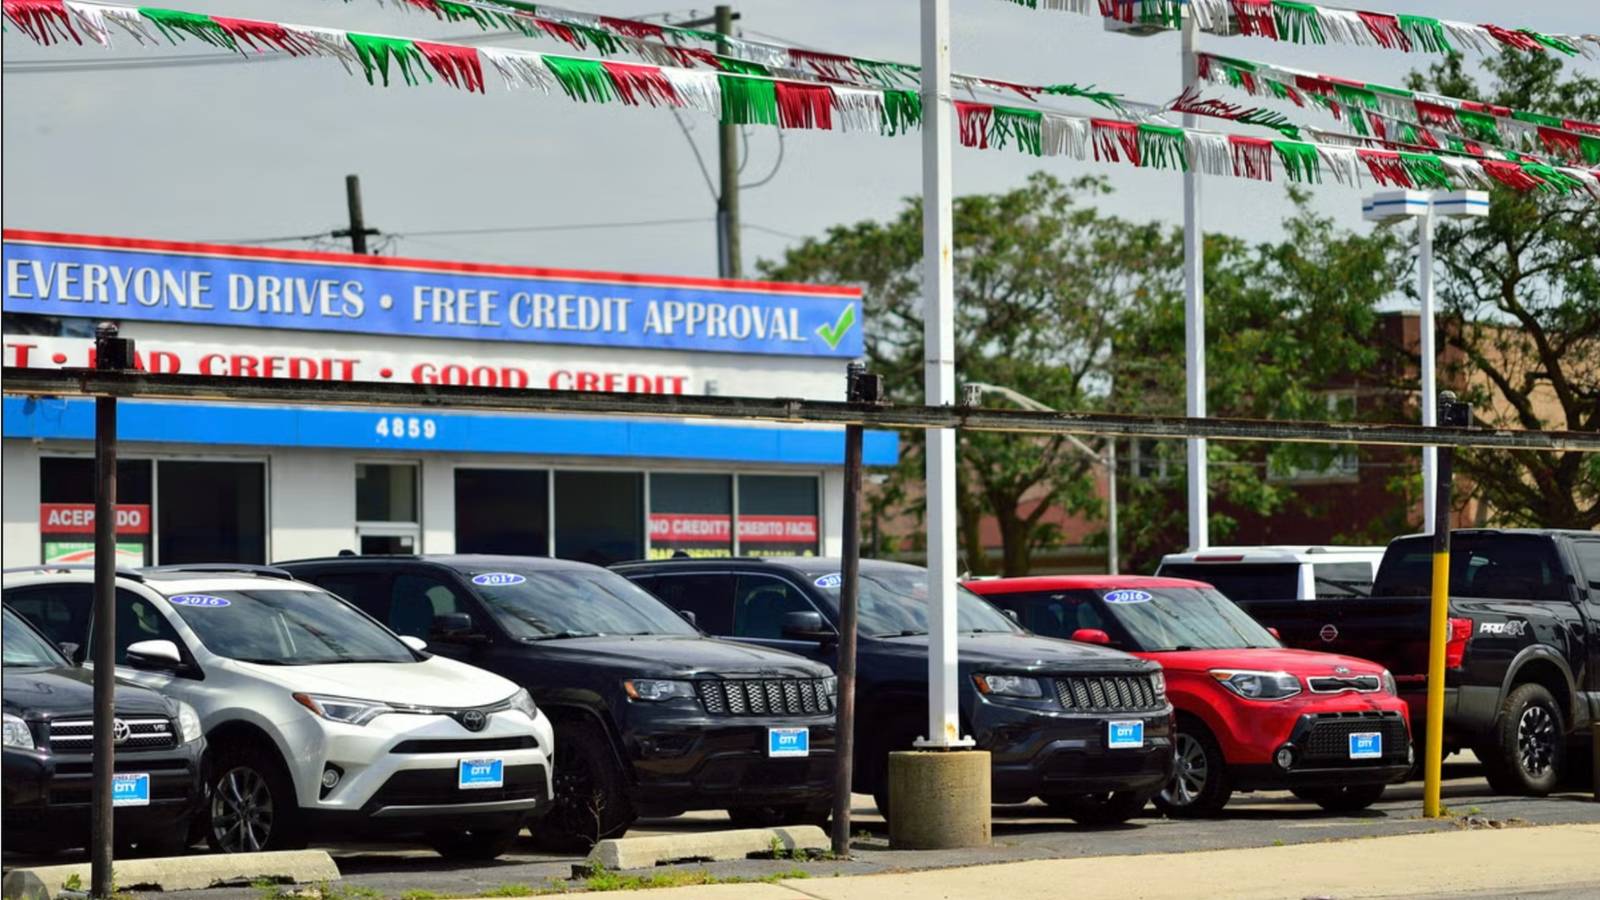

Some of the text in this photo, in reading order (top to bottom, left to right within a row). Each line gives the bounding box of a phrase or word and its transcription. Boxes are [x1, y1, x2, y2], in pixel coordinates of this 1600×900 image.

[7, 258, 807, 342] EVERYONE DRIVES FREE CREDIT APPROVAL
[411, 363, 529, 389] GOOD
[376, 416, 436, 439] 4859
[484, 574, 515, 585] 2017
[180, 596, 219, 606] 2016
[1114, 591, 1144, 603] 2016
[114, 782, 137, 792] CITY
